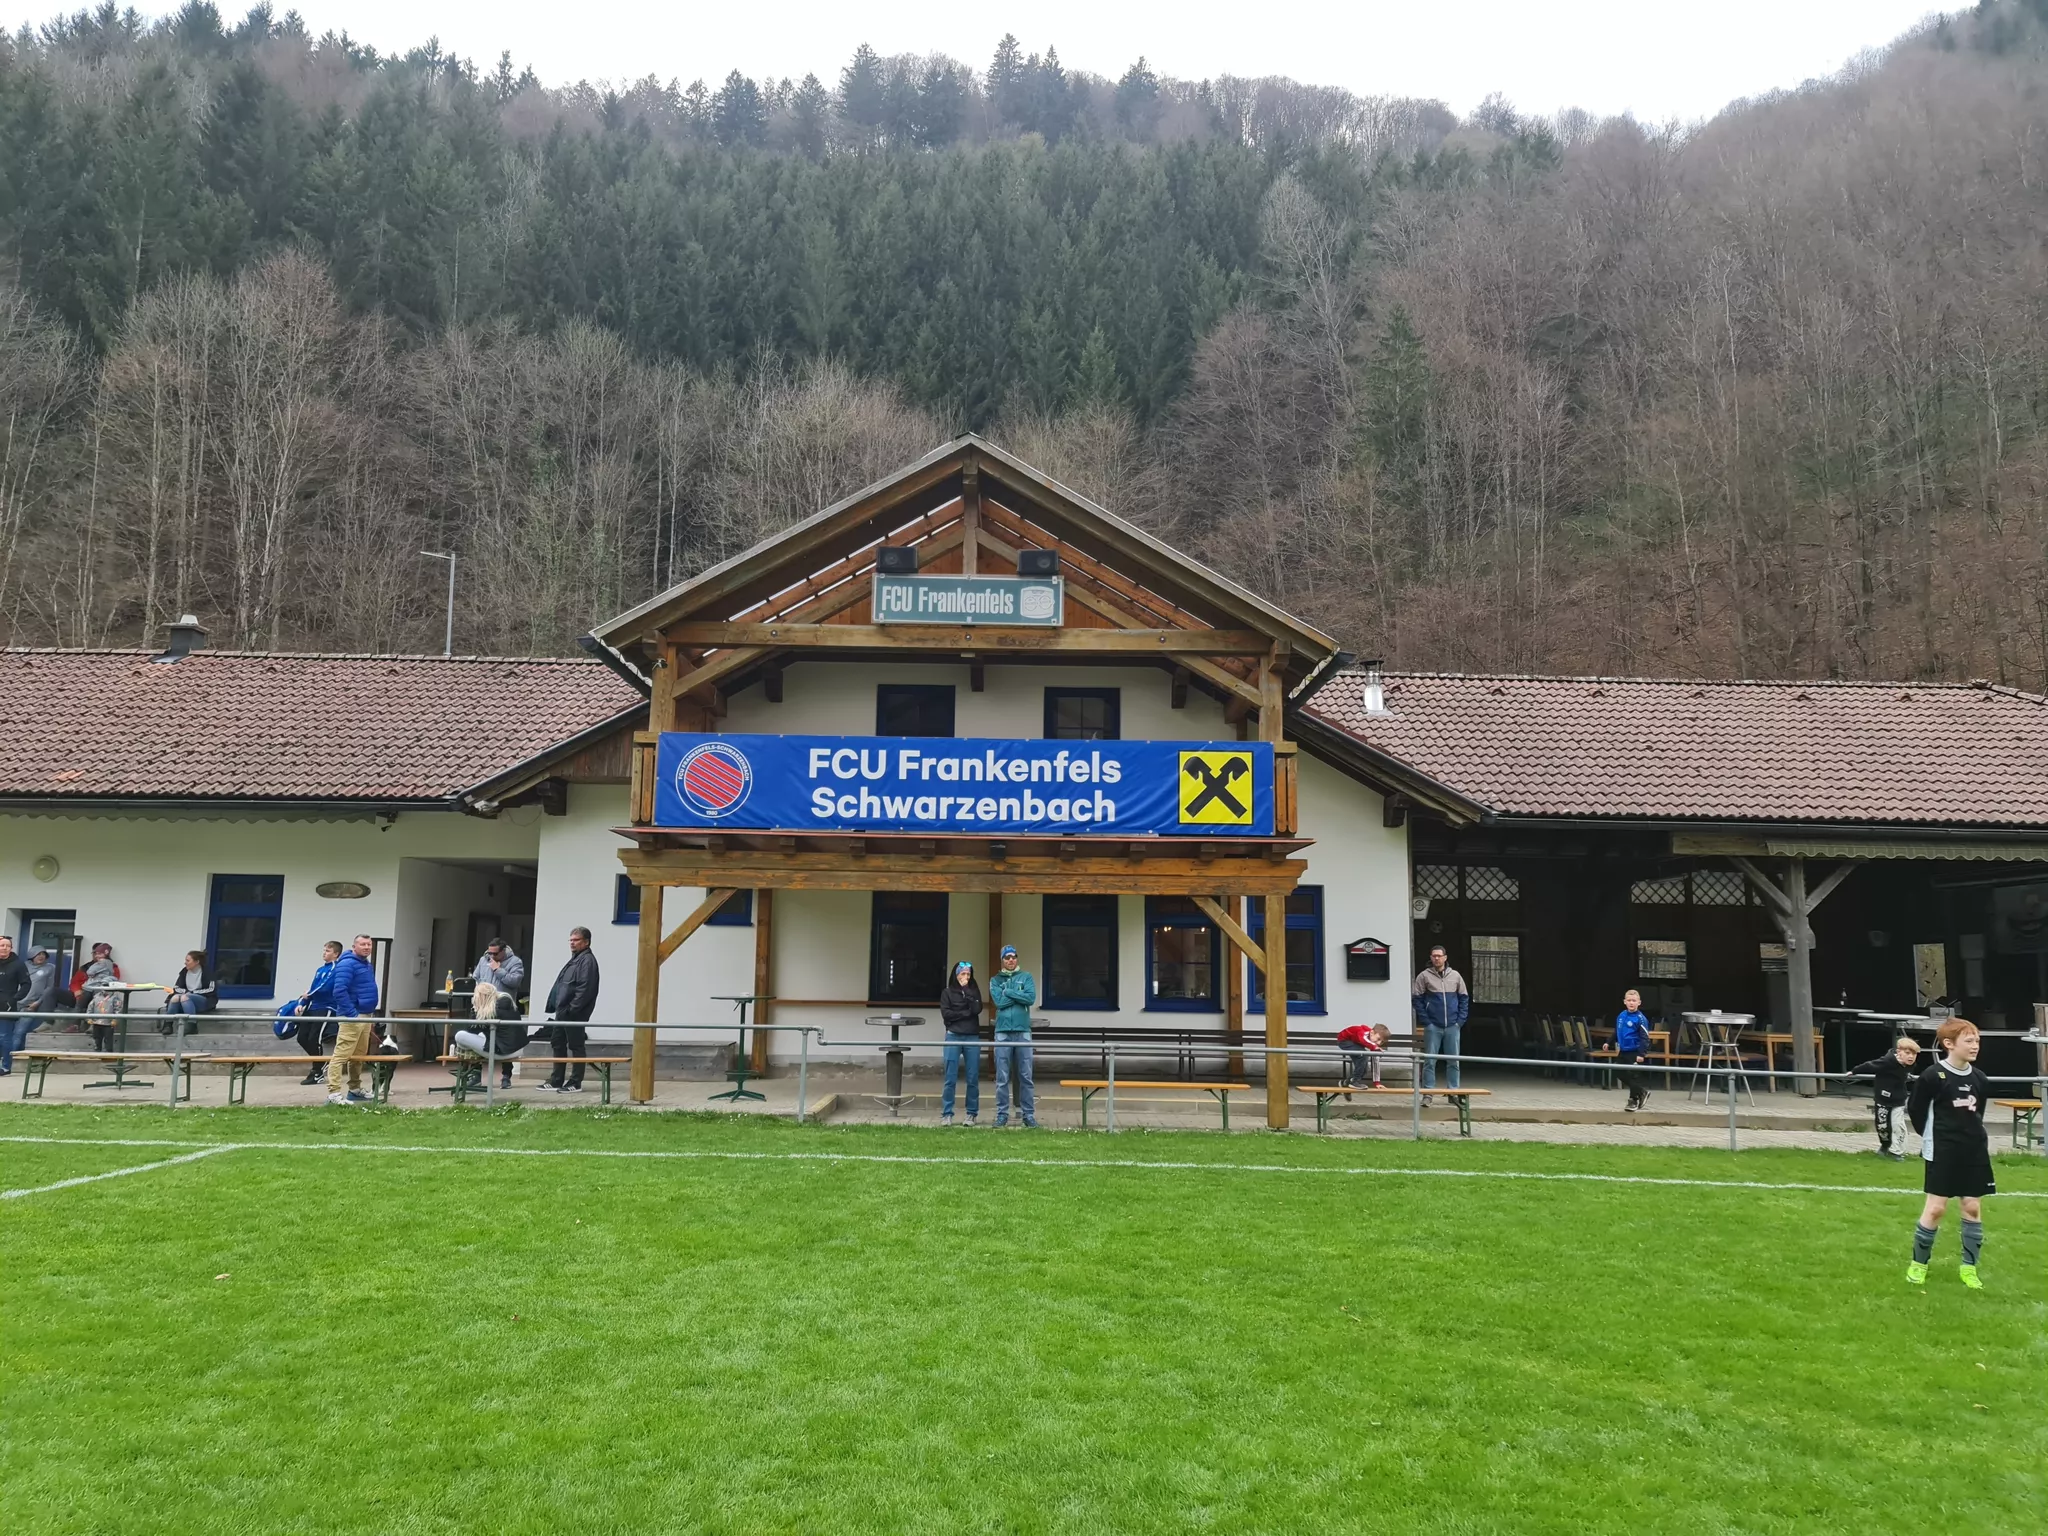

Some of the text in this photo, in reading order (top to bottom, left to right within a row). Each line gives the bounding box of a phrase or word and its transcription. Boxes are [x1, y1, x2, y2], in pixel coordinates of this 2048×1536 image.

[881, 586, 913, 612] FCU
[918, 586, 1014, 615] Frankenfels
[808, 748, 1122, 783] FCU Frankenfels
[811, 786, 1116, 822] Schwarzenbach
